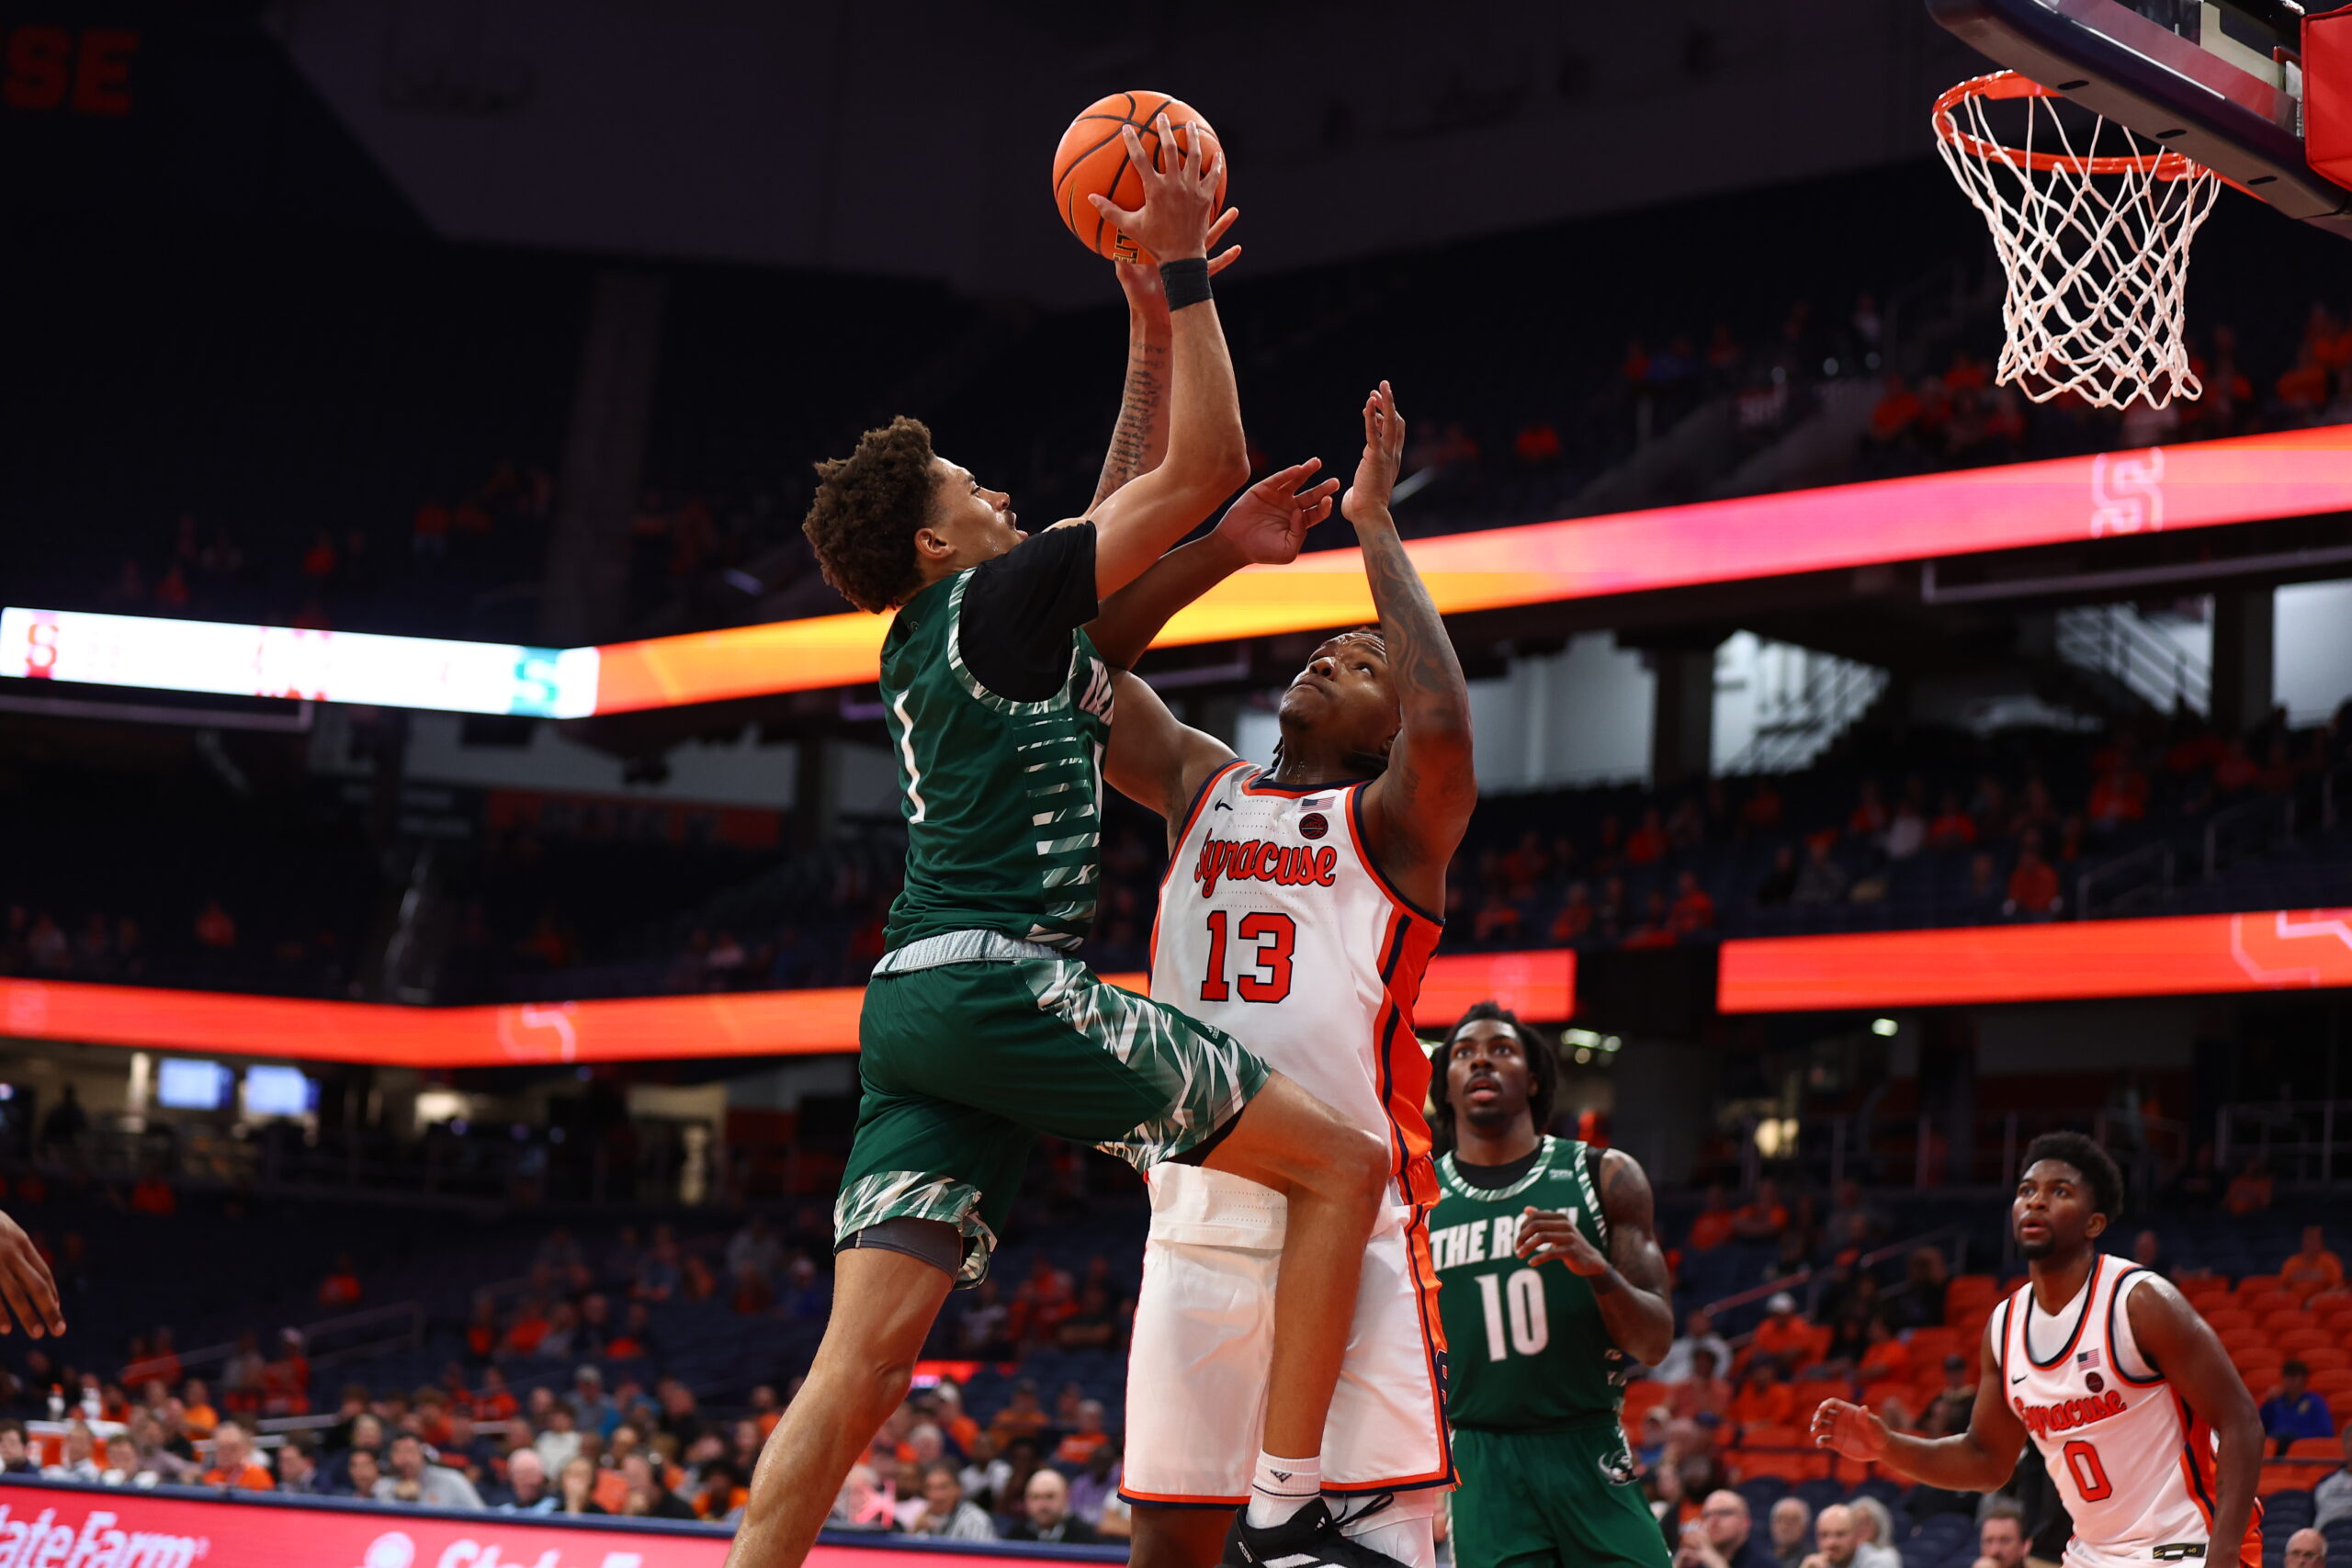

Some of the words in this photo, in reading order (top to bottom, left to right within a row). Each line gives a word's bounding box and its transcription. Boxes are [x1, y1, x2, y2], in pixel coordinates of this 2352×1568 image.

[1194, 827, 1337, 898] Syracuse
[1200, 910, 1296, 1004] 13
[1429, 1219, 1488, 1272] THE
[1475, 1268, 1549, 1362] 10
[2013, 1389, 2128, 1441] Syracuse
[2064, 1440, 2112, 1503] 0
